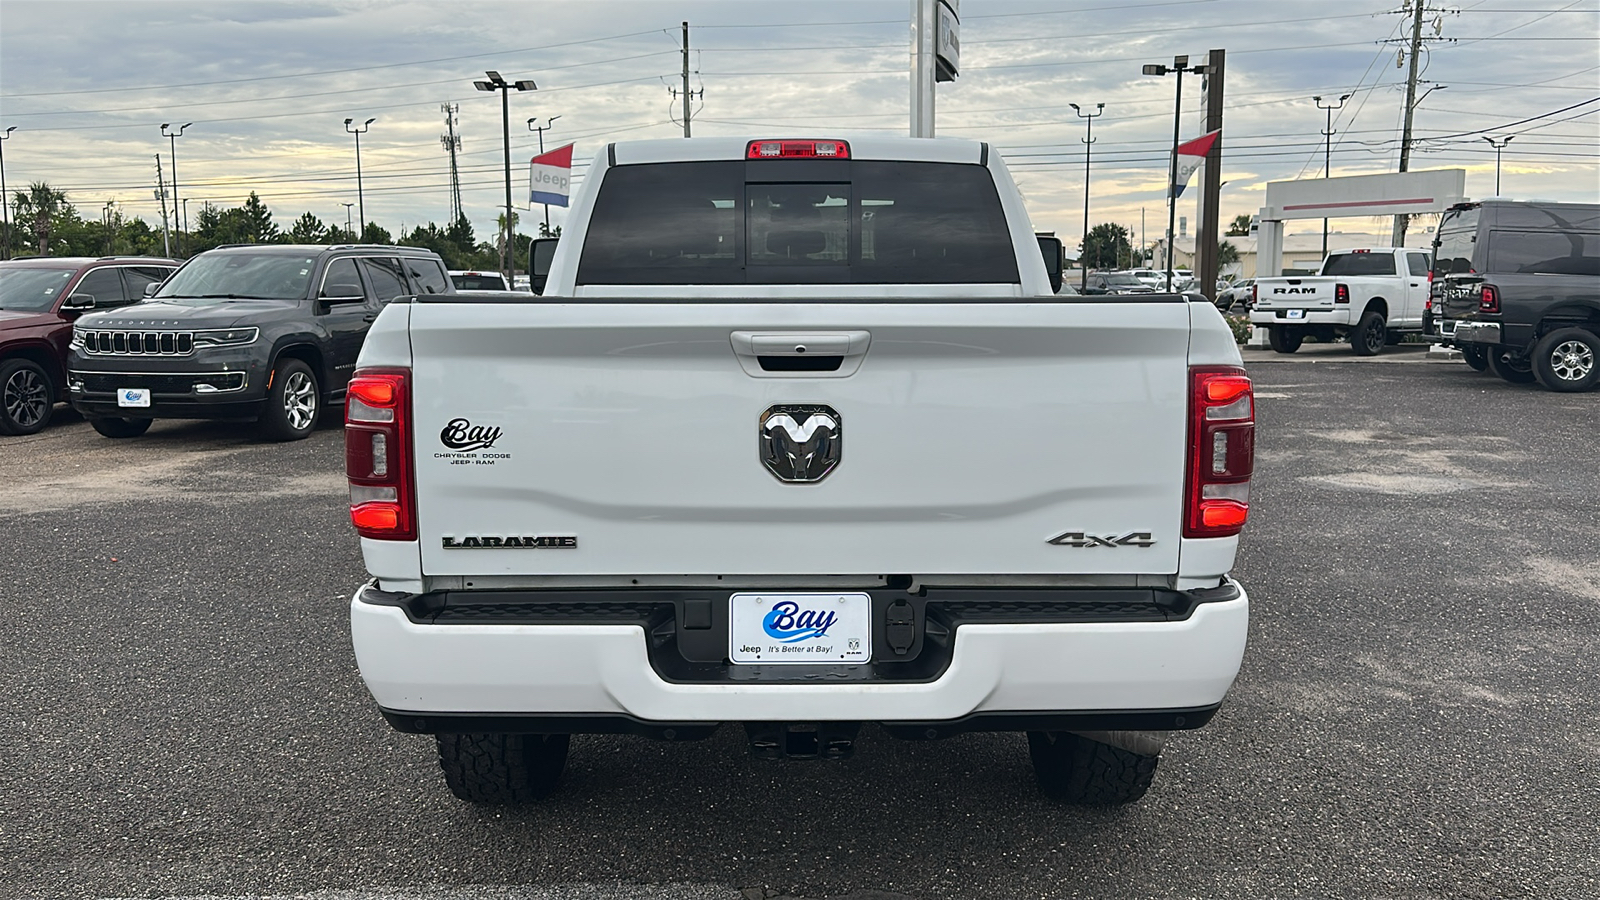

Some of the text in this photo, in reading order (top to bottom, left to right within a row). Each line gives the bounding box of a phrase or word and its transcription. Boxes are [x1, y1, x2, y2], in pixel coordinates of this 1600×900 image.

[534, 170, 568, 189] Jeep
[442, 417, 503, 450] Bay
[442, 536, 577, 549] LARAMIE
[767, 600, 838, 638] Bay
[739, 644, 762, 654] Jeep
[815, 645, 833, 654] Bay!
